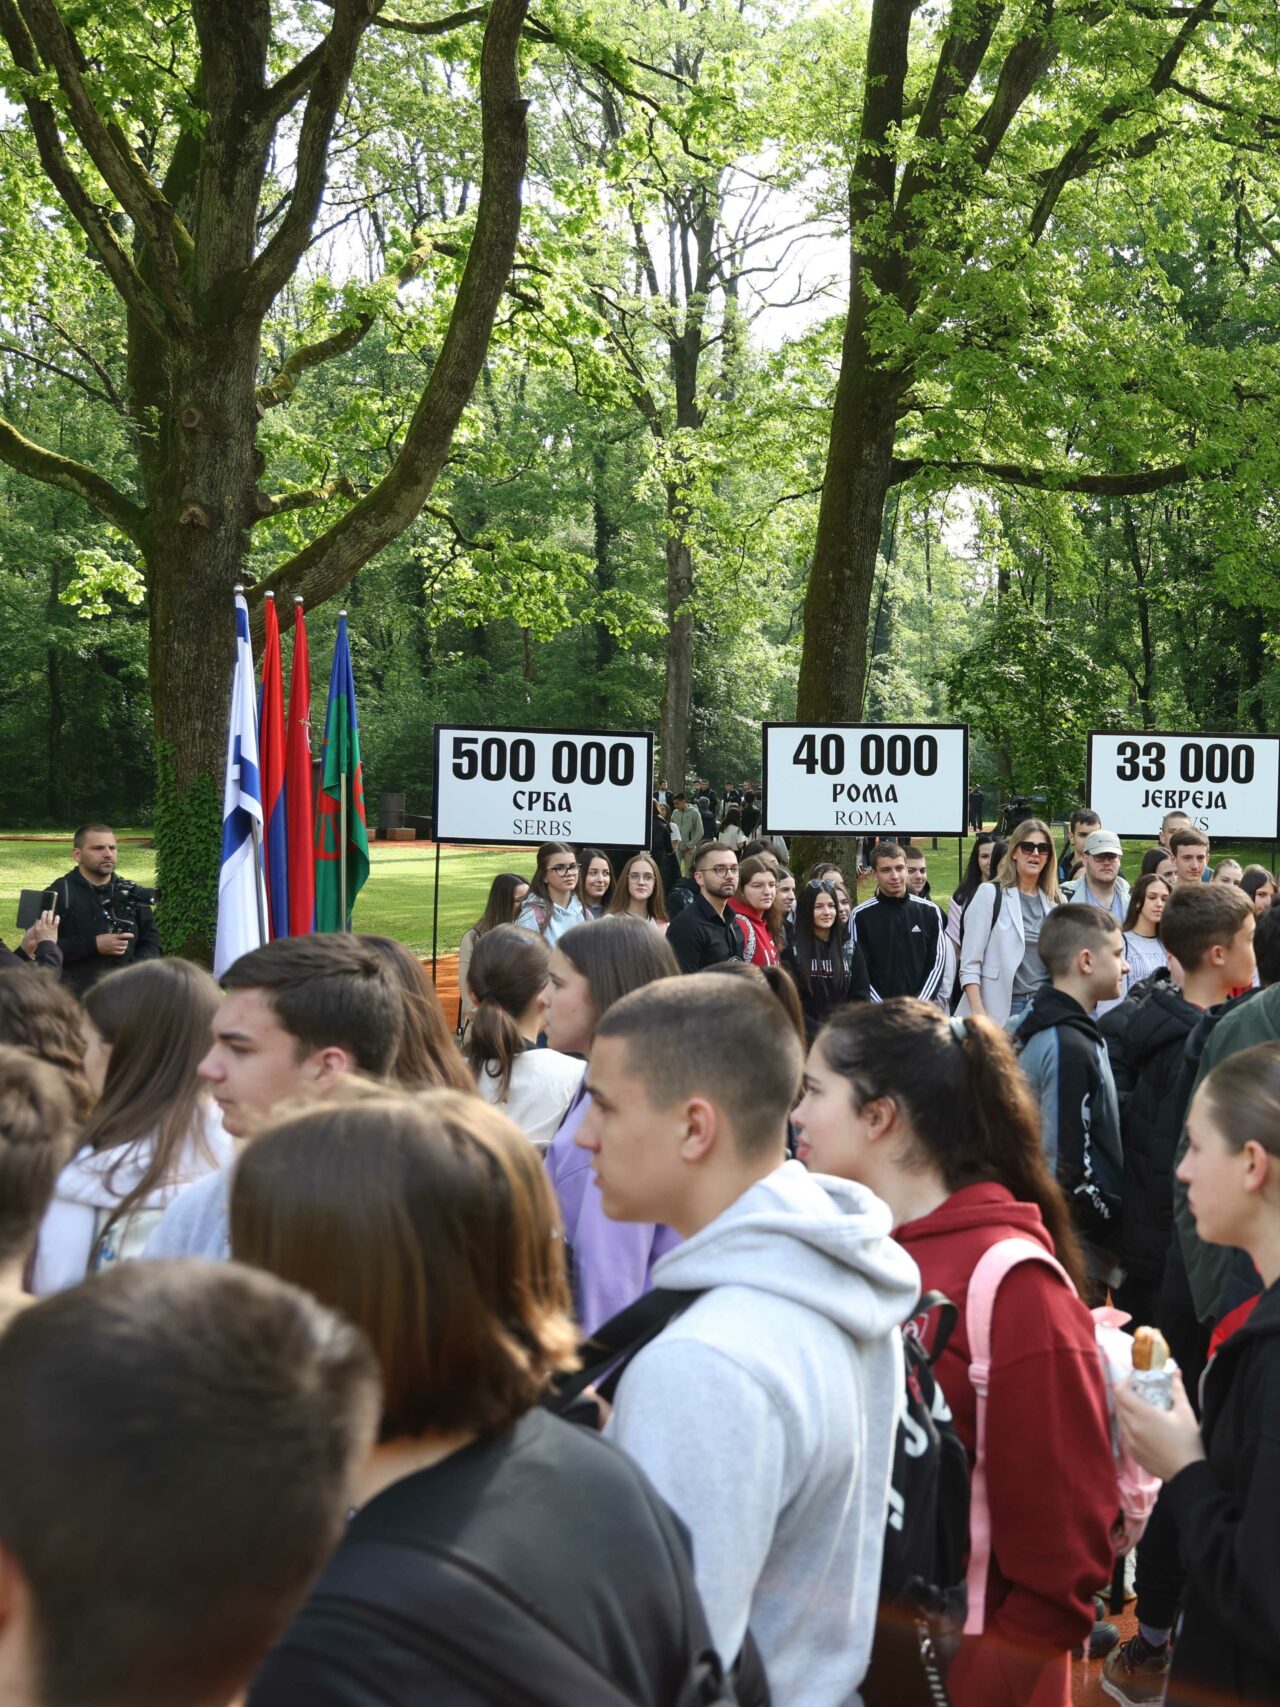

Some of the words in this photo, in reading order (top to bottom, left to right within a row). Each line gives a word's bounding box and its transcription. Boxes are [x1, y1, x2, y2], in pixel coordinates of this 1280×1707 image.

[452, 737, 535, 782] 500
[552, 741, 634, 786] 000
[793, 734, 844, 775] 40
[861, 734, 937, 776] 000
[1117, 741, 1165, 782] 33
[1180, 743, 1254, 784] 000
[513, 791, 572, 812] СРБА
[833, 784, 898, 803] РОМА
[1142, 790, 1227, 809] ЈЕВРЕЈА
[514, 819, 571, 836] SERBS
[836, 811, 896, 825] ROMA
